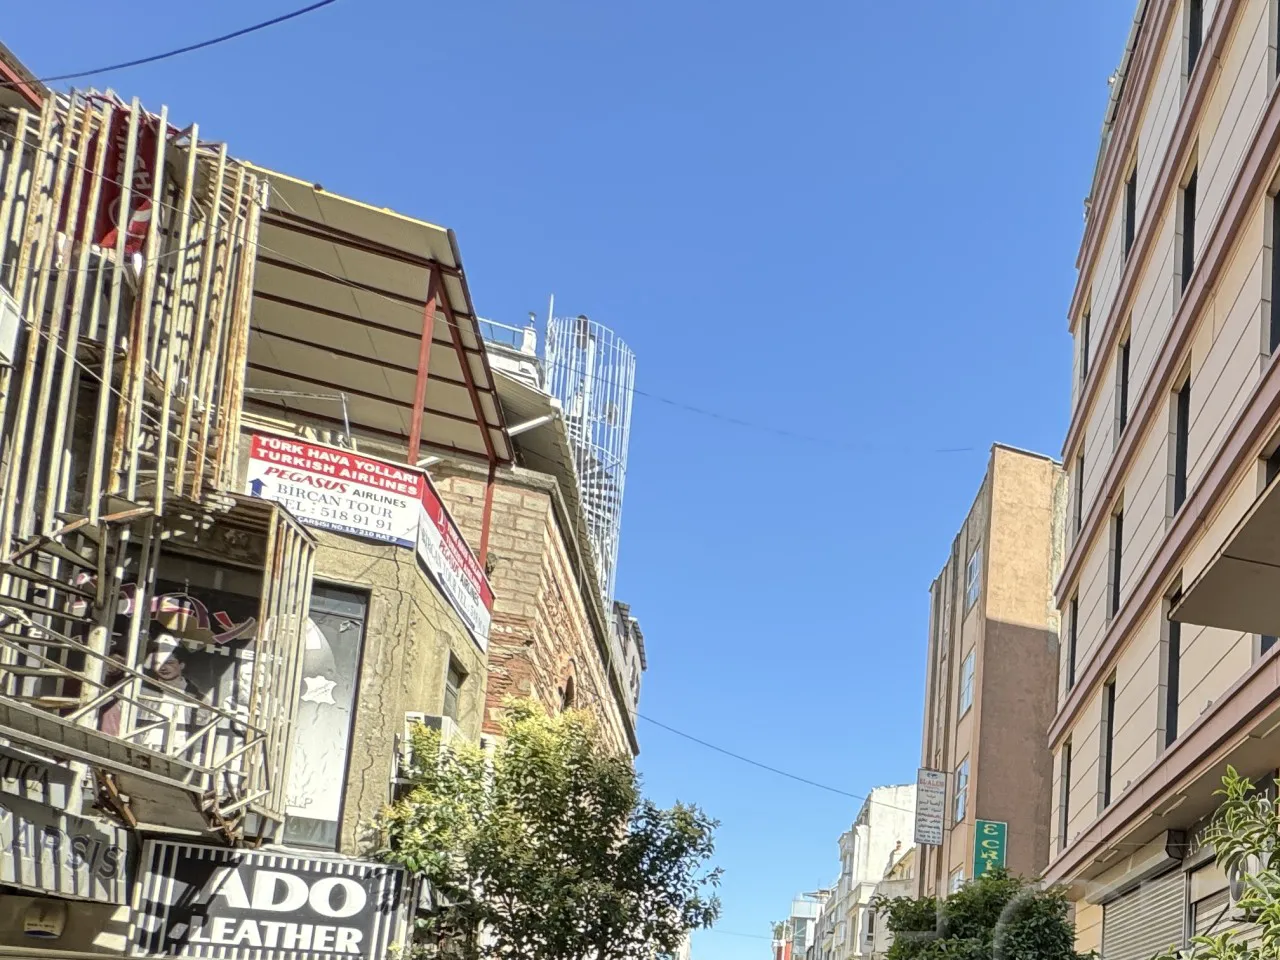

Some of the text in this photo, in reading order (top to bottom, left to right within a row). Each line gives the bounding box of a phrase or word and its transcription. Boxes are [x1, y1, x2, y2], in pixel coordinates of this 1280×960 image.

[257, 447, 418, 496] TURKISH AIRLINES
[259, 437, 419, 485] TÜRK HAVA YOLLARI
[264, 466, 407, 509] PEGASUS AIRLINES
[346, 499, 393, 519] TOUR
[320, 507, 349, 524] 518
[353, 513, 370, 528] 91
[376, 517, 393, 532] 91
[191, 867, 367, 918] ADO
[188, 916, 364, 954] LEATHER
